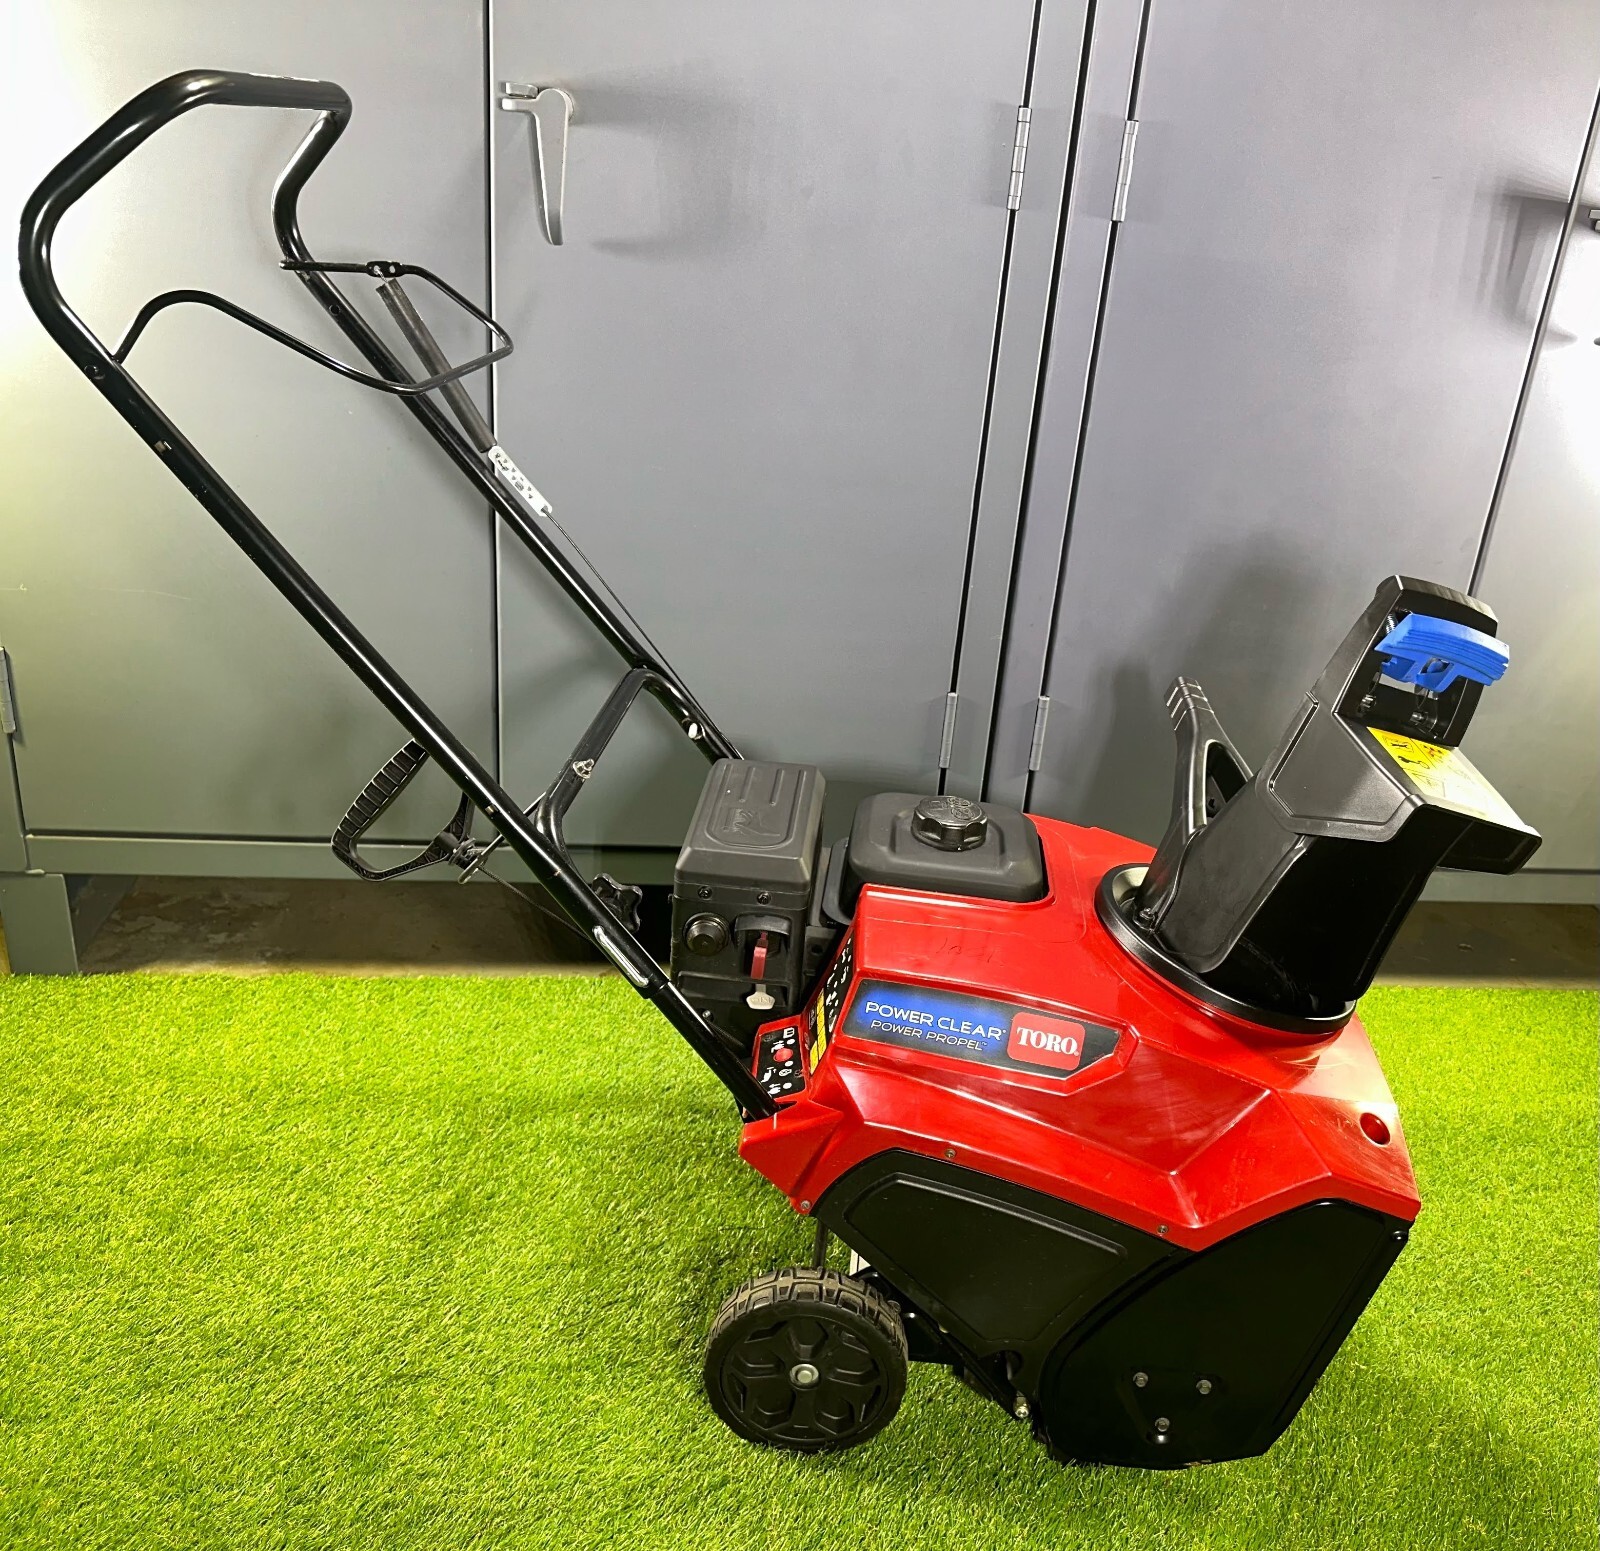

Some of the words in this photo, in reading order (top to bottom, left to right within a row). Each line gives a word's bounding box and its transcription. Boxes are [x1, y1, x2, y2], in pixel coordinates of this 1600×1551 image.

[865, 1001, 934, 1027] POWER
[870, 1019, 923, 1038] POWER
[1016, 1026, 1078, 1055] TORO
